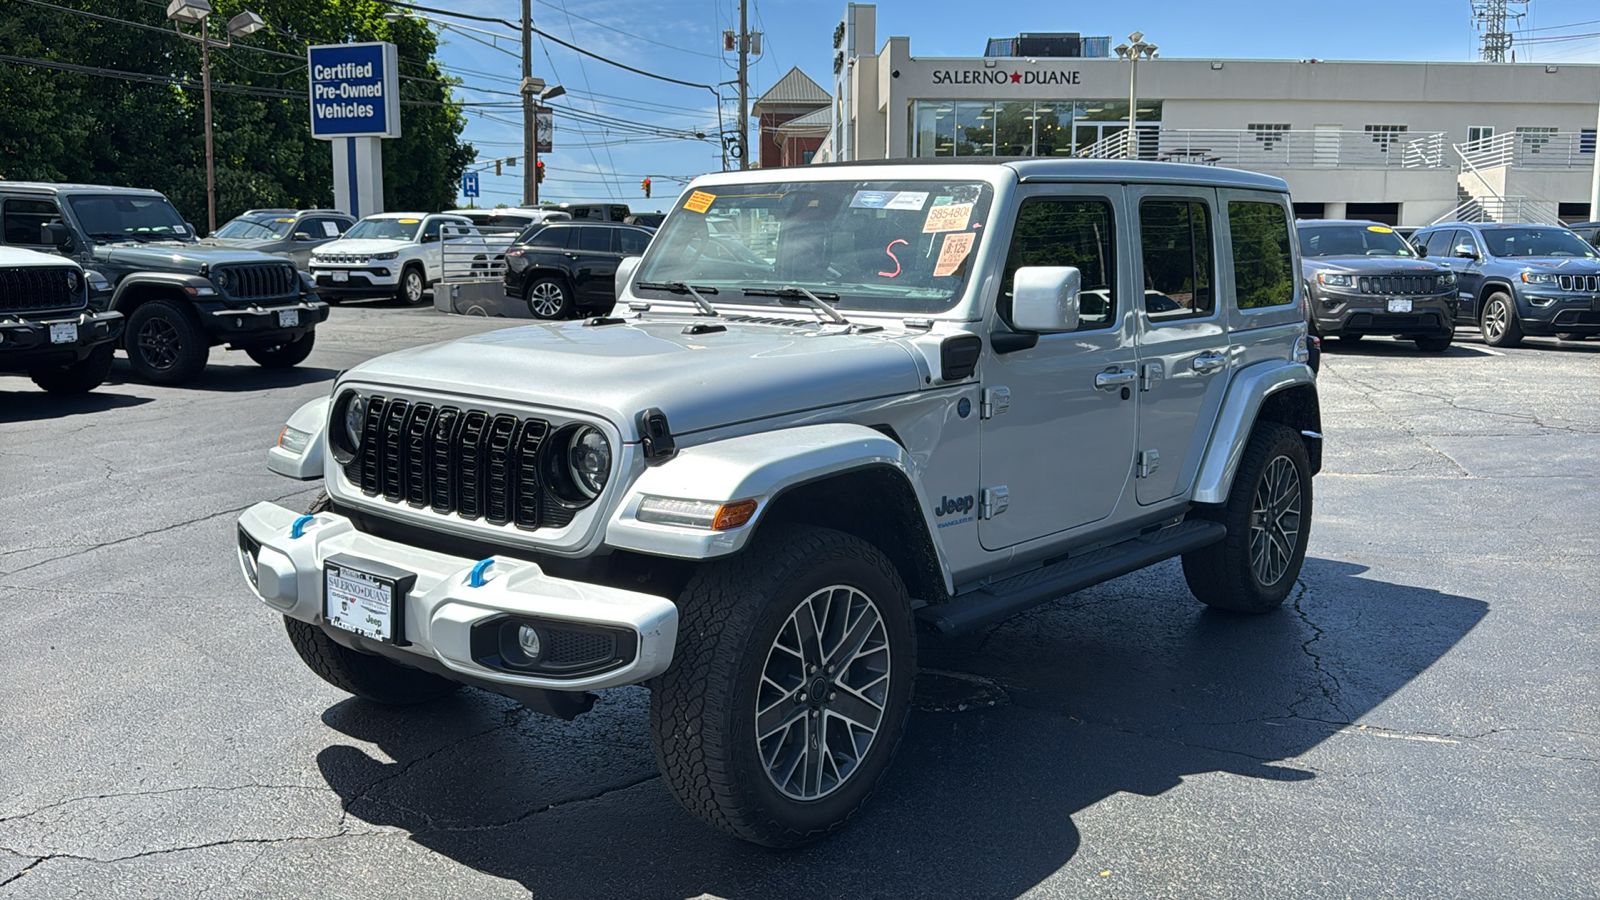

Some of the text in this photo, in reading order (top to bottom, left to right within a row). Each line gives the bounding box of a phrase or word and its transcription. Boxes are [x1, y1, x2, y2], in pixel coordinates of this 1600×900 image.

[314, 62, 373, 80] Certified
[932, 70, 1081, 85] SALERNO DUANE
[315, 81, 382, 99] Pre-Owned
[316, 102, 374, 119] Vehicles
[466, 177, 476, 190] H
[878, 239, 909, 278] S
[935, 494, 974, 517] Jeep
[328, 576, 391, 605] SALERNO DUANE
[366, 614, 382, 628] Jeep
